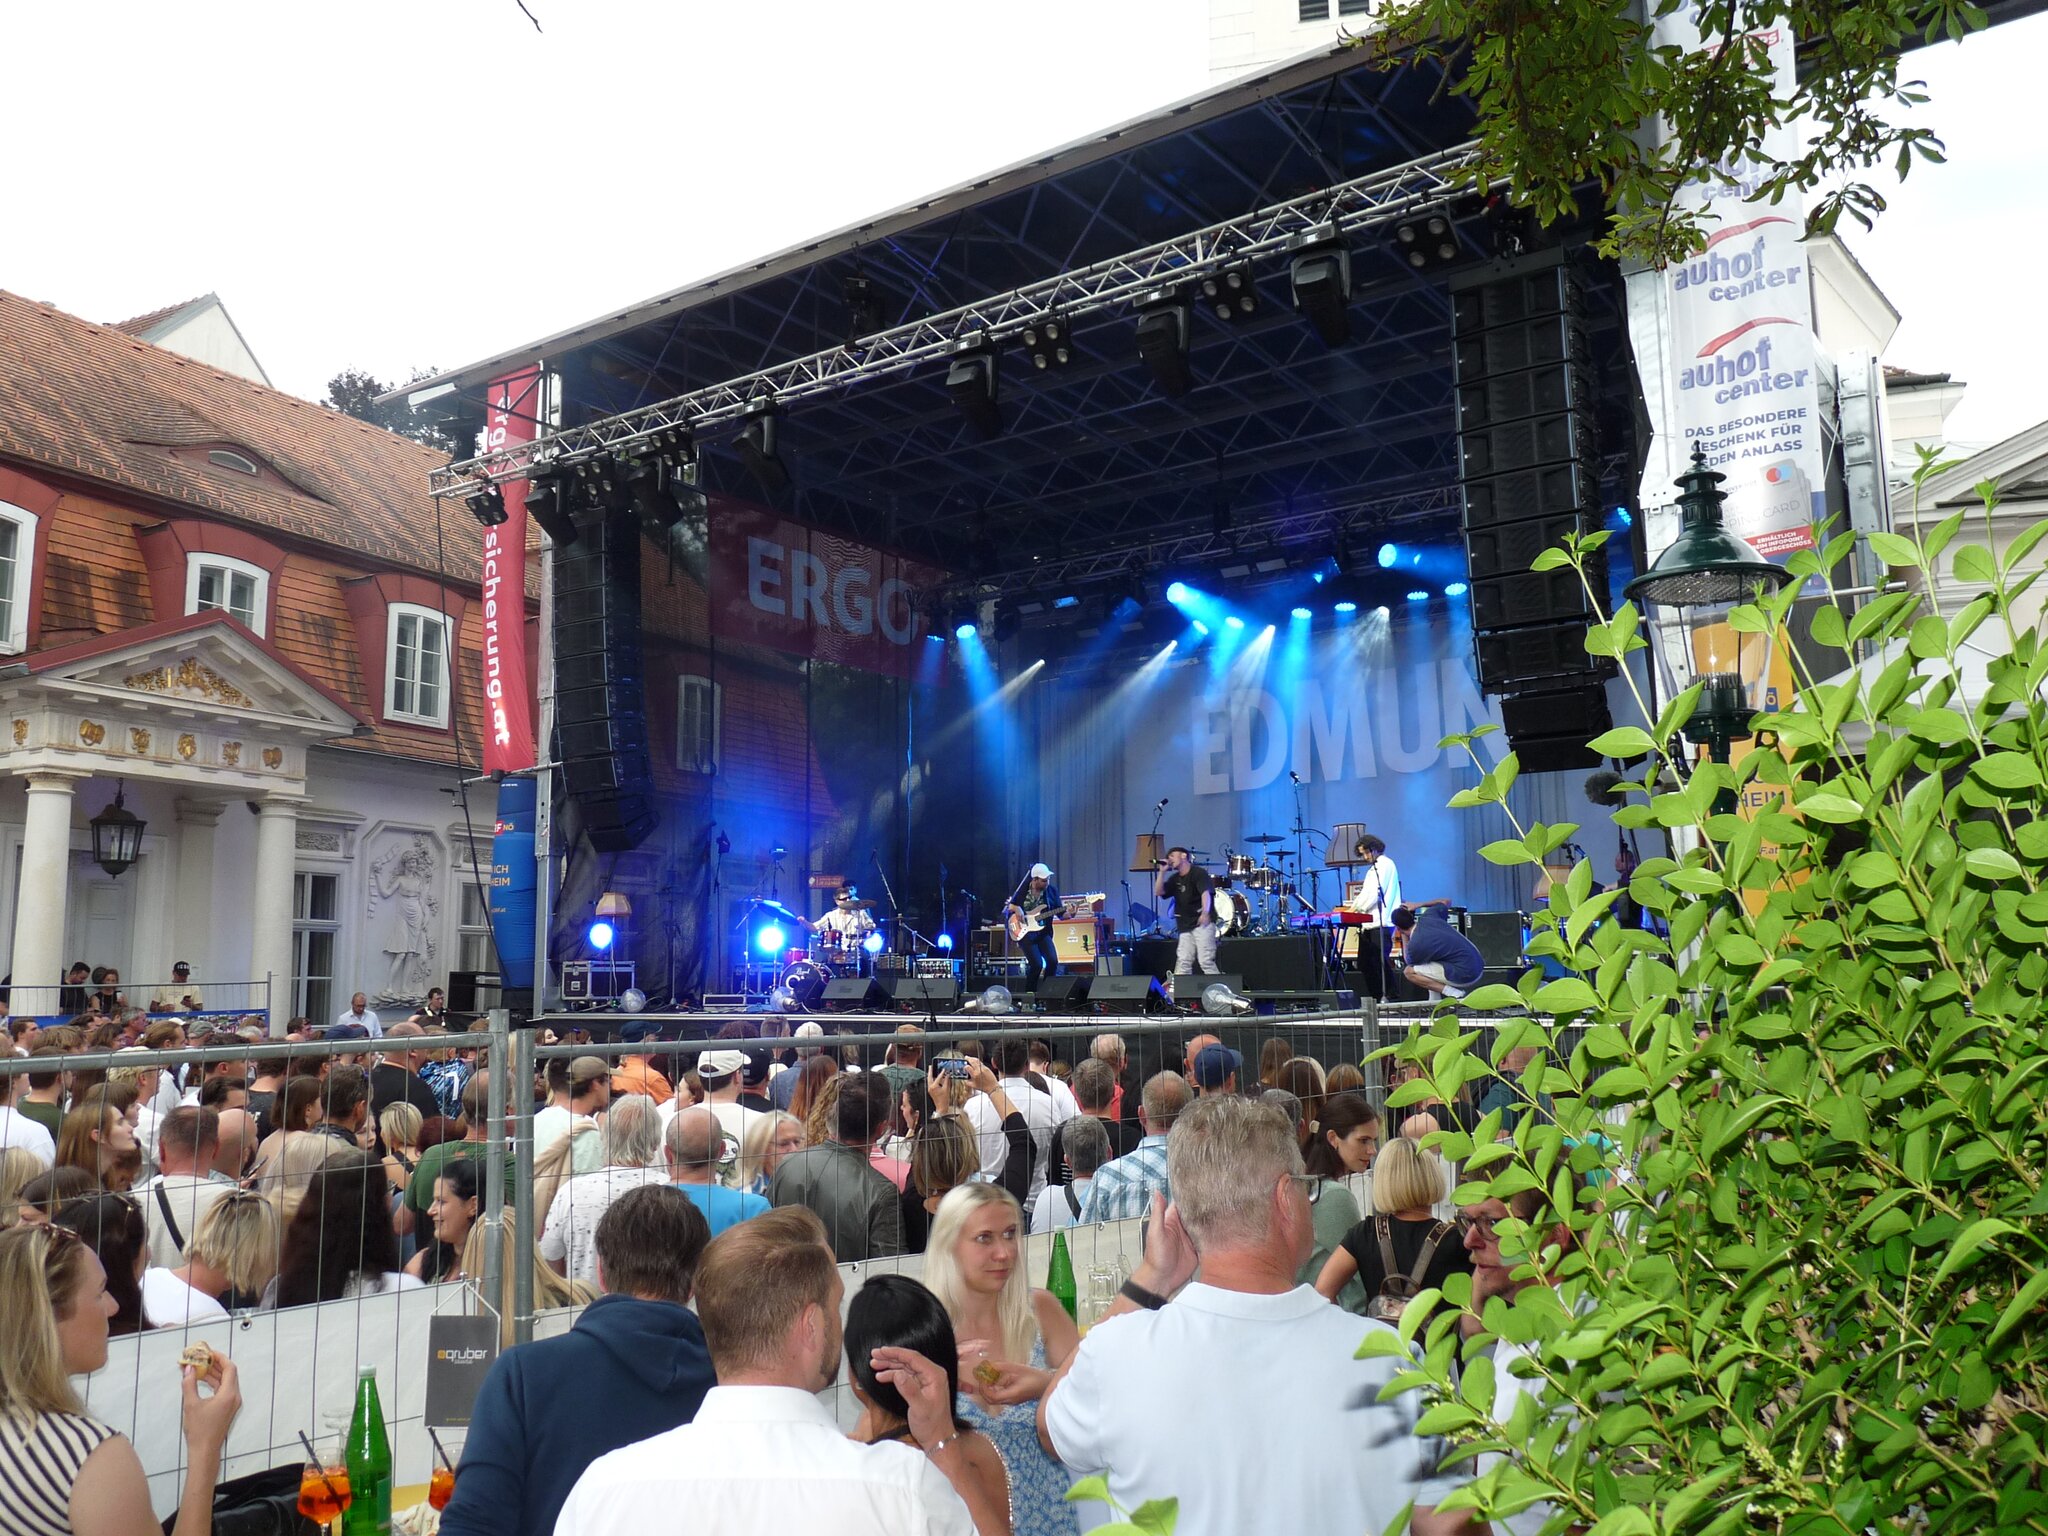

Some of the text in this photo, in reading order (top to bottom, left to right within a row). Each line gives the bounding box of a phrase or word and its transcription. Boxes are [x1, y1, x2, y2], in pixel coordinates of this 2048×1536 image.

[1674, 236, 1765, 291] auhof
[1708, 266, 1801, 302] center
[1679, 336, 1772, 391] auhof
[1715, 368, 1809, 405] center
[1685, 407, 1807, 438] DAS BESONDERE
[1771, 423, 1802, 437] FÜR
[1704, 440, 1803, 467] EDEN ANLASS
[1763, 499, 1801, 518] CARD
[1757, 532, 1797, 544] ERHÄLTLICH
[1760, 539, 1812, 554] OBERGESCHOSS
[1768, 535, 1804, 548] INFOPOINT
[747, 535, 919, 646] ERGO
